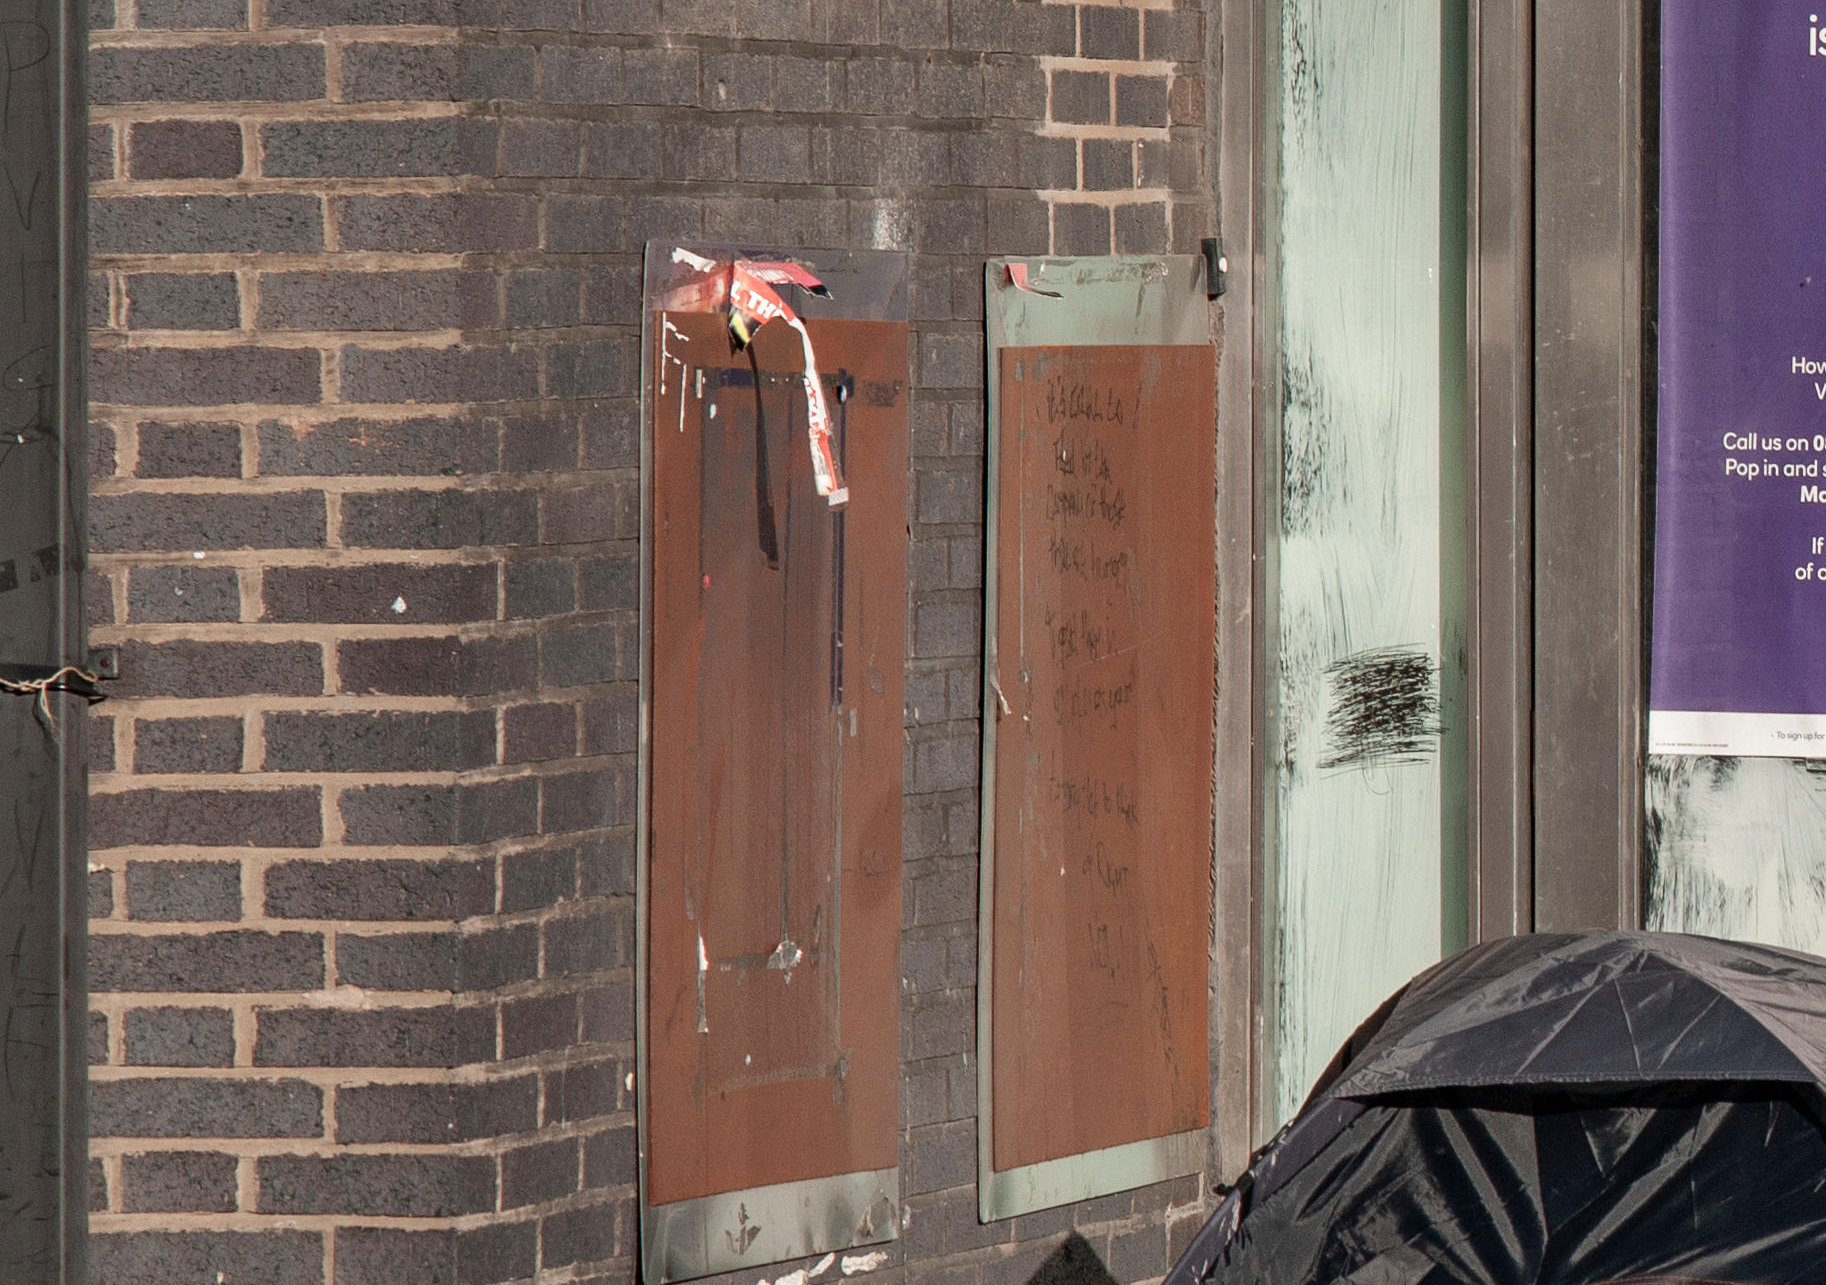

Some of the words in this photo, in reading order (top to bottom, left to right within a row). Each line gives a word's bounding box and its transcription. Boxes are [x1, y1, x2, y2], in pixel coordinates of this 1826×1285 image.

[1723, 431, 1758, 451] Call
[1761, 437, 1782, 451] us
[1785, 437, 1809, 452] on
[1725, 457, 1760, 481] Pop
[1763, 458, 1779, 476] in
[1783, 459, 1818, 478] and
[1812, 536, 1825, 555] If
[1794, 562, 1814, 581] of
[1776, 731, 1787, 741] To
[1787, 732, 1803, 743] sign
[1803, 733, 1814, 743] up
[1814, 732, 1826, 741] for
